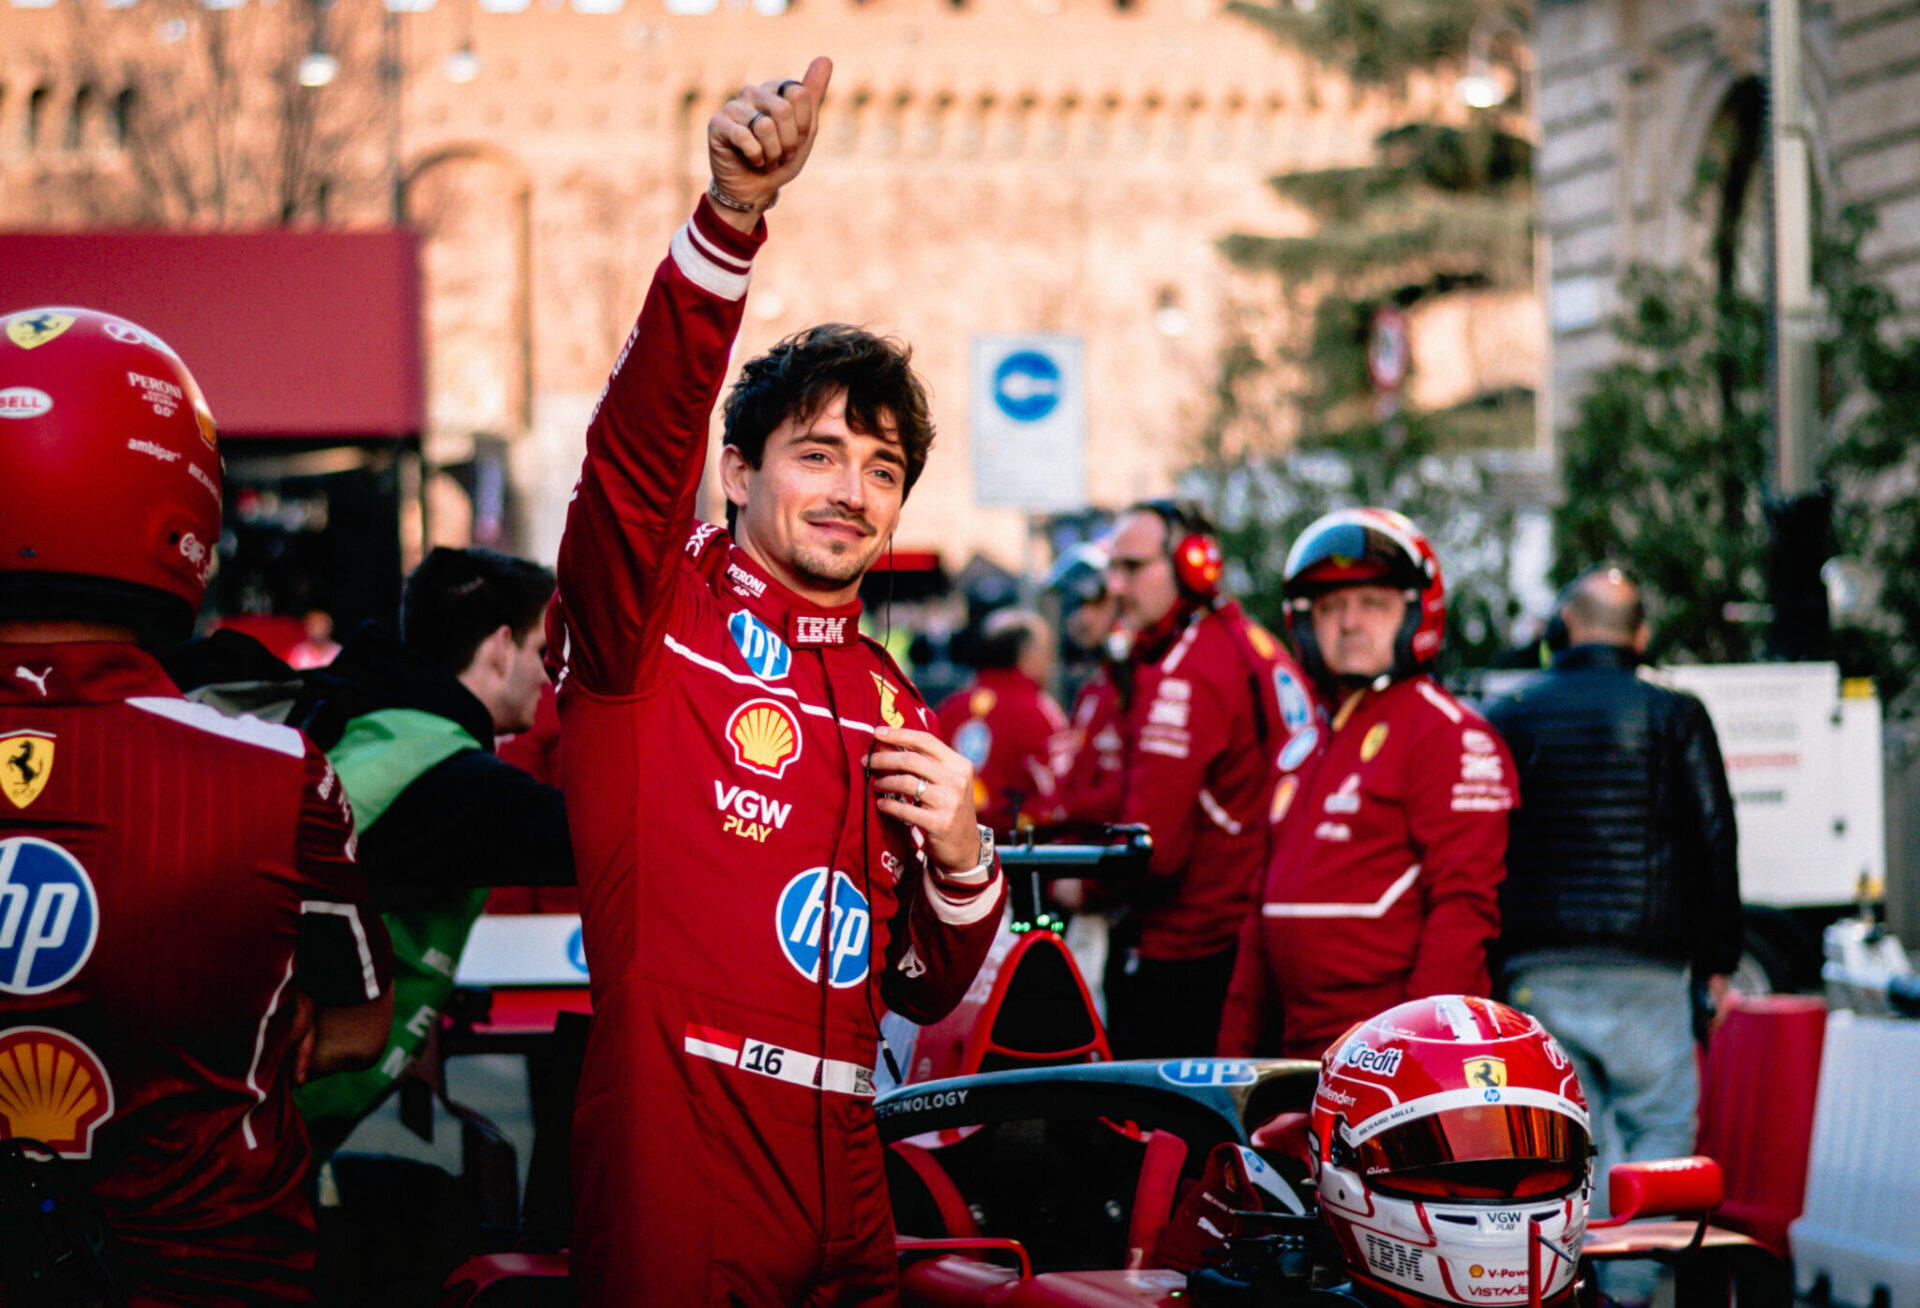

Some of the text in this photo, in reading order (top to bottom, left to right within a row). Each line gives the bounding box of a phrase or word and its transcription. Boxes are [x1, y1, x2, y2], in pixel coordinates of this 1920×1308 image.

[127, 371, 183, 400] PERONI
[127, 438, 177, 463] ambipar
[726, 563, 767, 594] PERONI
[797, 616, 847, 643] IBM
[739, 609, 787, 681] hp
[714, 780, 792, 829] VGW
[723, 815, 773, 843] PLAY
[788, 866, 870, 988] hp
[745, 1044, 785, 1076] 16
[1179, 1059, 1241, 1085] hp
[876, 1090, 968, 1119] TECHNOLOGY
[1358, 1105, 1416, 1137] RICHARD MILLE
[1487, 1211, 1522, 1223] VGW
[1366, 1233, 1424, 1282] IBM
